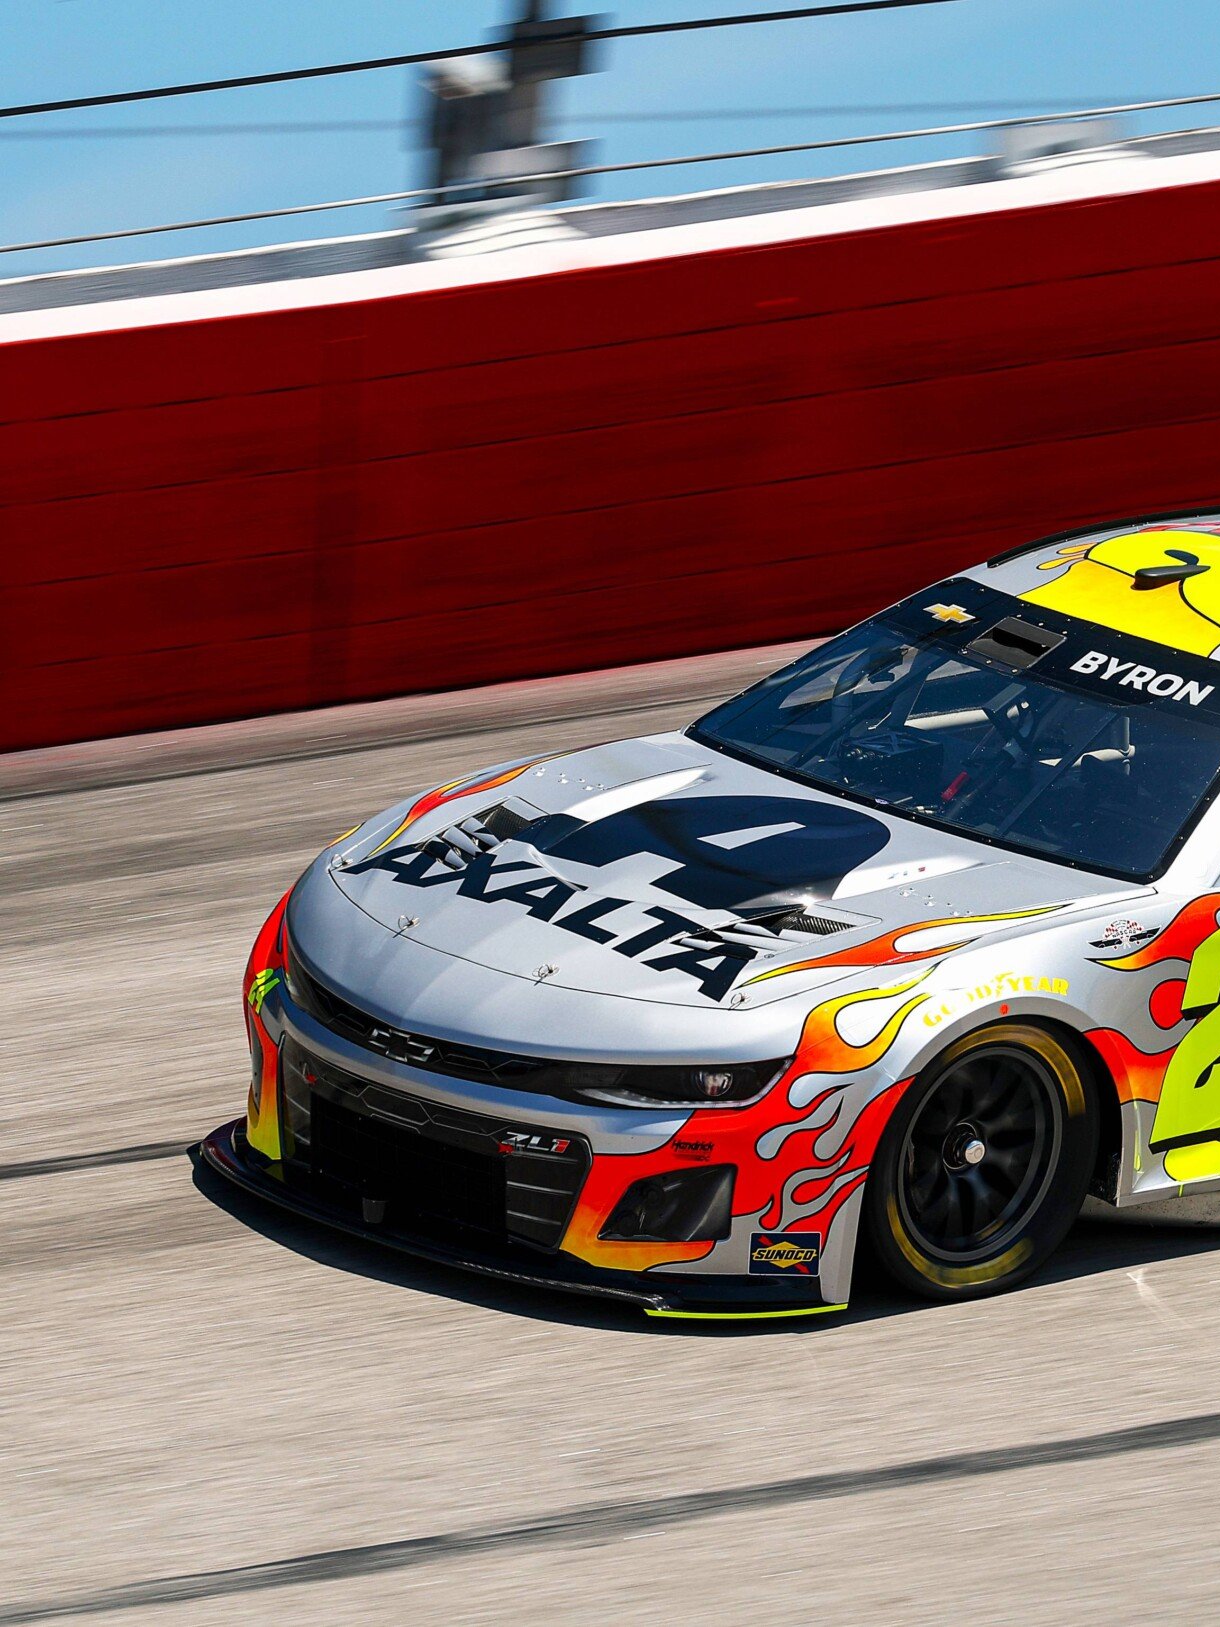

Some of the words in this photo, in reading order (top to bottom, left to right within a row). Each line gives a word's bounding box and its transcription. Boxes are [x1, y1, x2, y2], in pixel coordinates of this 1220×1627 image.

[1069, 650, 1216, 706] BYRON
[338, 842, 758, 1003] AXALTA
[922, 973, 1070, 1028] GDYEAR
[753, 1249, 816, 1261] SUNOCO
